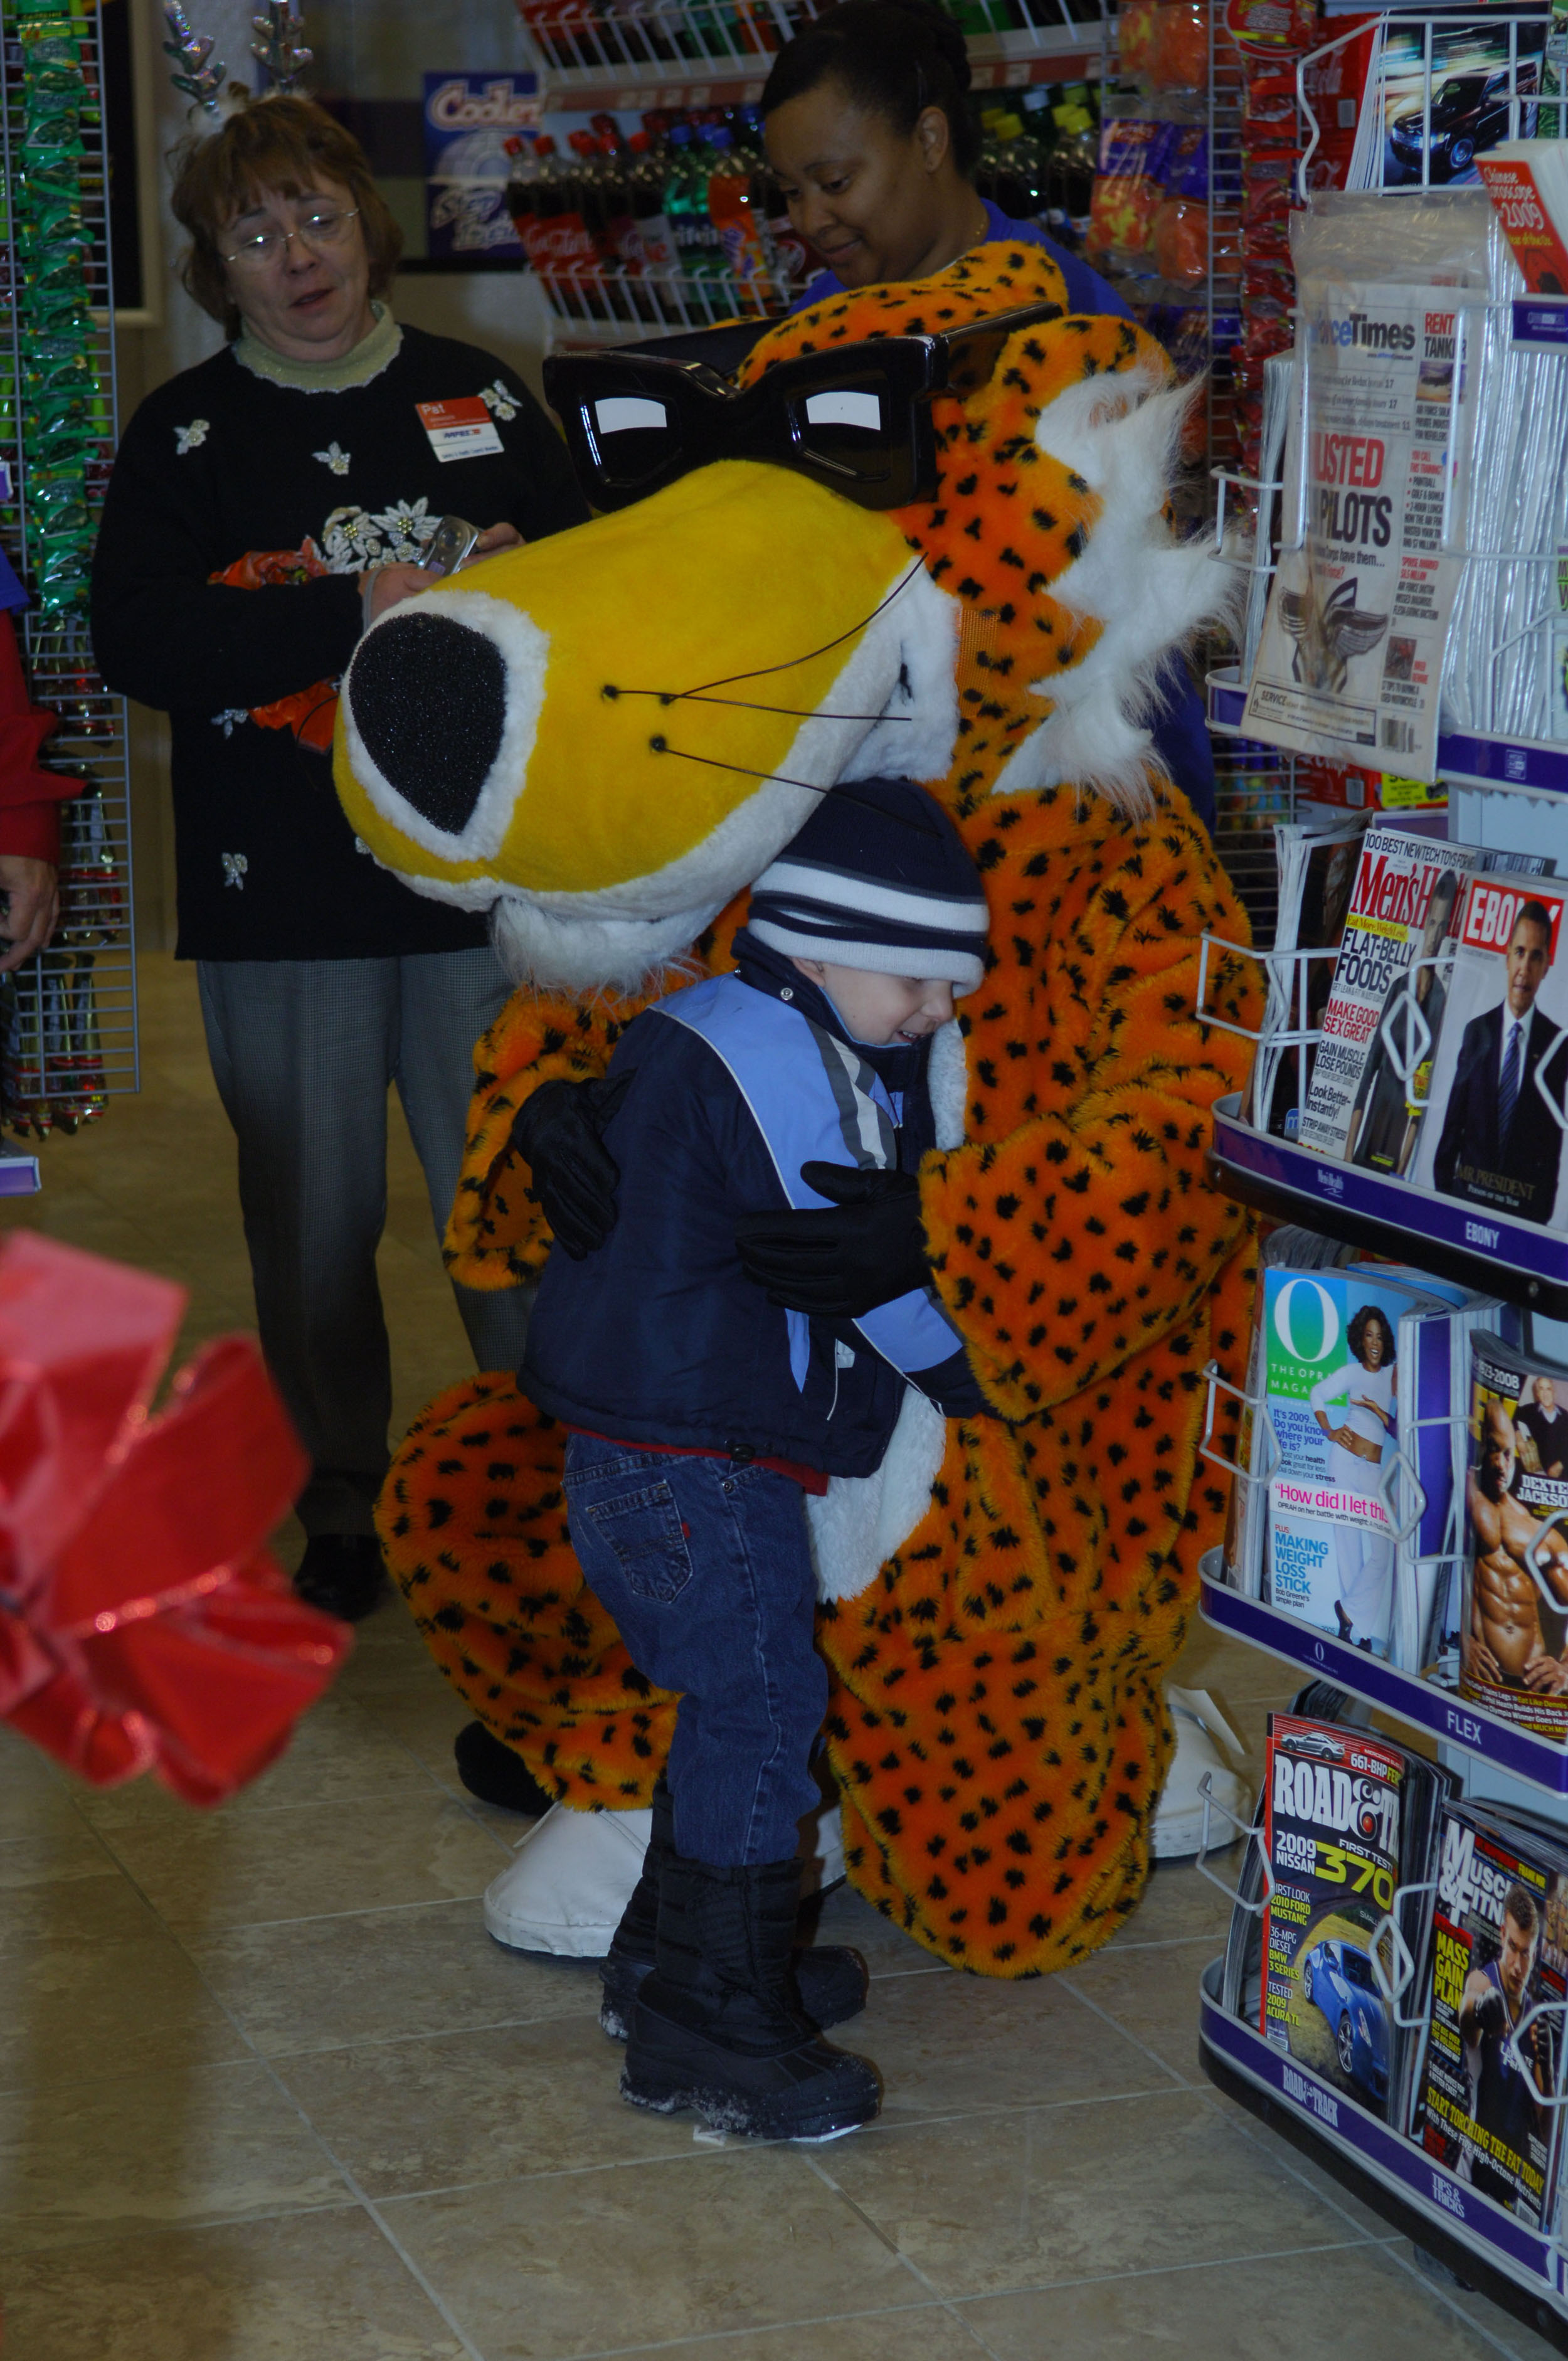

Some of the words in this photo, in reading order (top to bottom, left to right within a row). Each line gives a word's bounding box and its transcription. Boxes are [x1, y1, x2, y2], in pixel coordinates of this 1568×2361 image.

[1484, 166, 1518, 184] Chinese
[1490, 185, 1535, 201] oroscope
[1502, 202, 1544, 230] 2009
[1425, 312, 1455, 335] RENT
[1424, 336, 1466, 359] TANKR
[421, 403, 445, 415] Pat
[1389, 400, 1397, 408] 17
[1315, 433, 1385, 489] LISTED
[1320, 488, 1392, 548] PILOTS
[1340, 548, 1355, 563] have
[1261, 691, 1287, 706] SERVICE
[1365, 833, 1382, 849] 100
[1382, 837, 1405, 854] BEST
[1404, 842, 1423, 859] NEW
[1422, 847, 1440, 863] TECH
[1441, 851, 1457, 867] TOYS
[1350, 851, 1419, 926] Men's
[1412, 864, 1468, 939] Hlt
[1347, 915, 1359, 926] Eat
[1466, 887, 1560, 946] EBO
[1342, 927, 1417, 968] FLAT-BELLY
[1335, 952, 1393, 995] FOODS
[1328, 998, 1357, 1021] MAKE
[1356, 1007, 1379, 1027] GOOD
[1323, 1016, 1345, 1037] SEX
[1343, 1021, 1371, 1044] GREAT
[1319, 1040, 1338, 1058] GAIN
[1337, 1045, 1365, 1065] MUSCLE
[1316, 1054, 1337, 1072] LOSE
[1335, 1059, 1363, 1080] POUNDS
[1309, 1081, 1328, 1098] Look
[1306, 1096, 1340, 1122] Instantly!
[1302, 1117, 1318, 1130] STRIP
[1318, 1120, 1330, 1133] AWAY
[1331, 1124, 1347, 1141] STRESS
[1475, 1170, 1535, 1201] PRESIDENT
[1465, 1221, 1500, 1249] EBONY
[1274, 1278, 1339, 1362] O
[1271, 1364, 1295, 1376] THE
[1299, 1369, 1330, 1381] OPR
[1274, 1409, 1287, 1419] It's
[1289, 1411, 1318, 1425] 2009...
[1274, 1419, 1286, 1428] Do
[1287, 1422, 1303, 1433] you
[1276, 1430, 1302, 1442] where
[1304, 1435, 1325, 1446] your
[1289, 1443, 1301, 1451] is?
[1281, 1458, 1291, 1467] ook
[1293, 1462, 1306, 1472] great
[1315, 1465, 1326, 1473] less
[1293, 1455, 1305, 1463] your
[1305, 1455, 1325, 1465] health
[1303, 1470, 1315, 1479] your
[1315, 1473, 1335, 1483] stress
[1522, 1474, 1568, 1493] DEXTE
[1316, 1491, 1339, 1510] did
[1342, 1494, 1347, 1511] I
[1350, 1496, 1367, 1515] let
[1517, 1487, 1568, 1507] JACKSO
[1278, 1501, 1297, 1512] OPRAH
[1305, 1507, 1315, 1516] her
[1316, 1509, 1335, 1519] battle
[1335, 1512, 1348, 1521] with
[1275, 1532, 1328, 1555] MAKING
[1276, 1546, 1325, 1568] WEIGHT
[1276, 1559, 1306, 1579] LOSS
[1276, 1574, 1311, 1594] STICK
[1276, 1588, 1286, 1597] Bob
[1286, 1591, 1310, 1602] Greene's
[1276, 1595, 1292, 1606] simple
[1293, 1599, 1305, 1608] plan
[1315, 1642, 1324, 1662] O
[1513, 1704, 1534, 1713] Builds
[1534, 1707, 1545, 1715] His
[1546, 1709, 1562, 1717] Back
[1529, 1699, 1544, 1707] Like
[1448, 1710, 1481, 1744] FLEX
[1513, 1712, 1535, 1722] Winner
[1536, 1716, 1552, 1724] Goes
[1533, 1723, 1554, 1732] MUCH
[1350, 1753, 1387, 1778] 661-BHP
[1276, 1830, 1316, 1859] 2009
[1339, 1838, 1369, 1858] FIRST
[1276, 1850, 1315, 1876] NISSAN
[1442, 1818, 1512, 1900] MUSC
[1275, 1883, 1293, 1898] IRST
[1292, 1887, 1311, 1903] LOOK
[1271, 1895, 1290, 1909] 2010
[1290, 1899, 1311, 1914] FORD
[1271, 1906, 1307, 1926] MUSTANG
[1269, 1926, 1297, 1945] 36-MPG
[1269, 1938, 1292, 1955] DIESEL
[1269, 1948, 1287, 1965] BMW
[1437, 1930, 1470, 1971] MASS
[1269, 1960, 1274, 1971] 3
[1274, 1963, 1300, 1980] SERIES
[1435, 1952, 1465, 1992] GAIN
[1267, 1993, 1286, 2008] 2009
[1268, 1982, 1293, 2000] TESTED
[1434, 1973, 1463, 2010] PLAN
[1267, 2005, 1289, 2023] ACURA
[1290, 2015, 1300, 2027] TL
[1427, 2085, 1451, 2117] START
[1449, 2104, 1490, 2149] TORCHING
[1490, 2135, 1507, 2163] THE
[1505, 2146, 1522, 2173] FAT
[1521, 2161, 1545, 2195] TODAY
[1427, 2105, 1439, 2124] With
[1441, 2118, 1457, 2141] These
[1458, 2134, 1472, 2152] Five
[1473, 2147, 1513, 2184] High-Octane
[1515, 2178, 1541, 2210] Nutrients
[1432, 2172, 1452, 2196] TIPS
[1453, 2187, 1461, 2203] &
[1433, 2185, 1465, 2219] TRICKS
